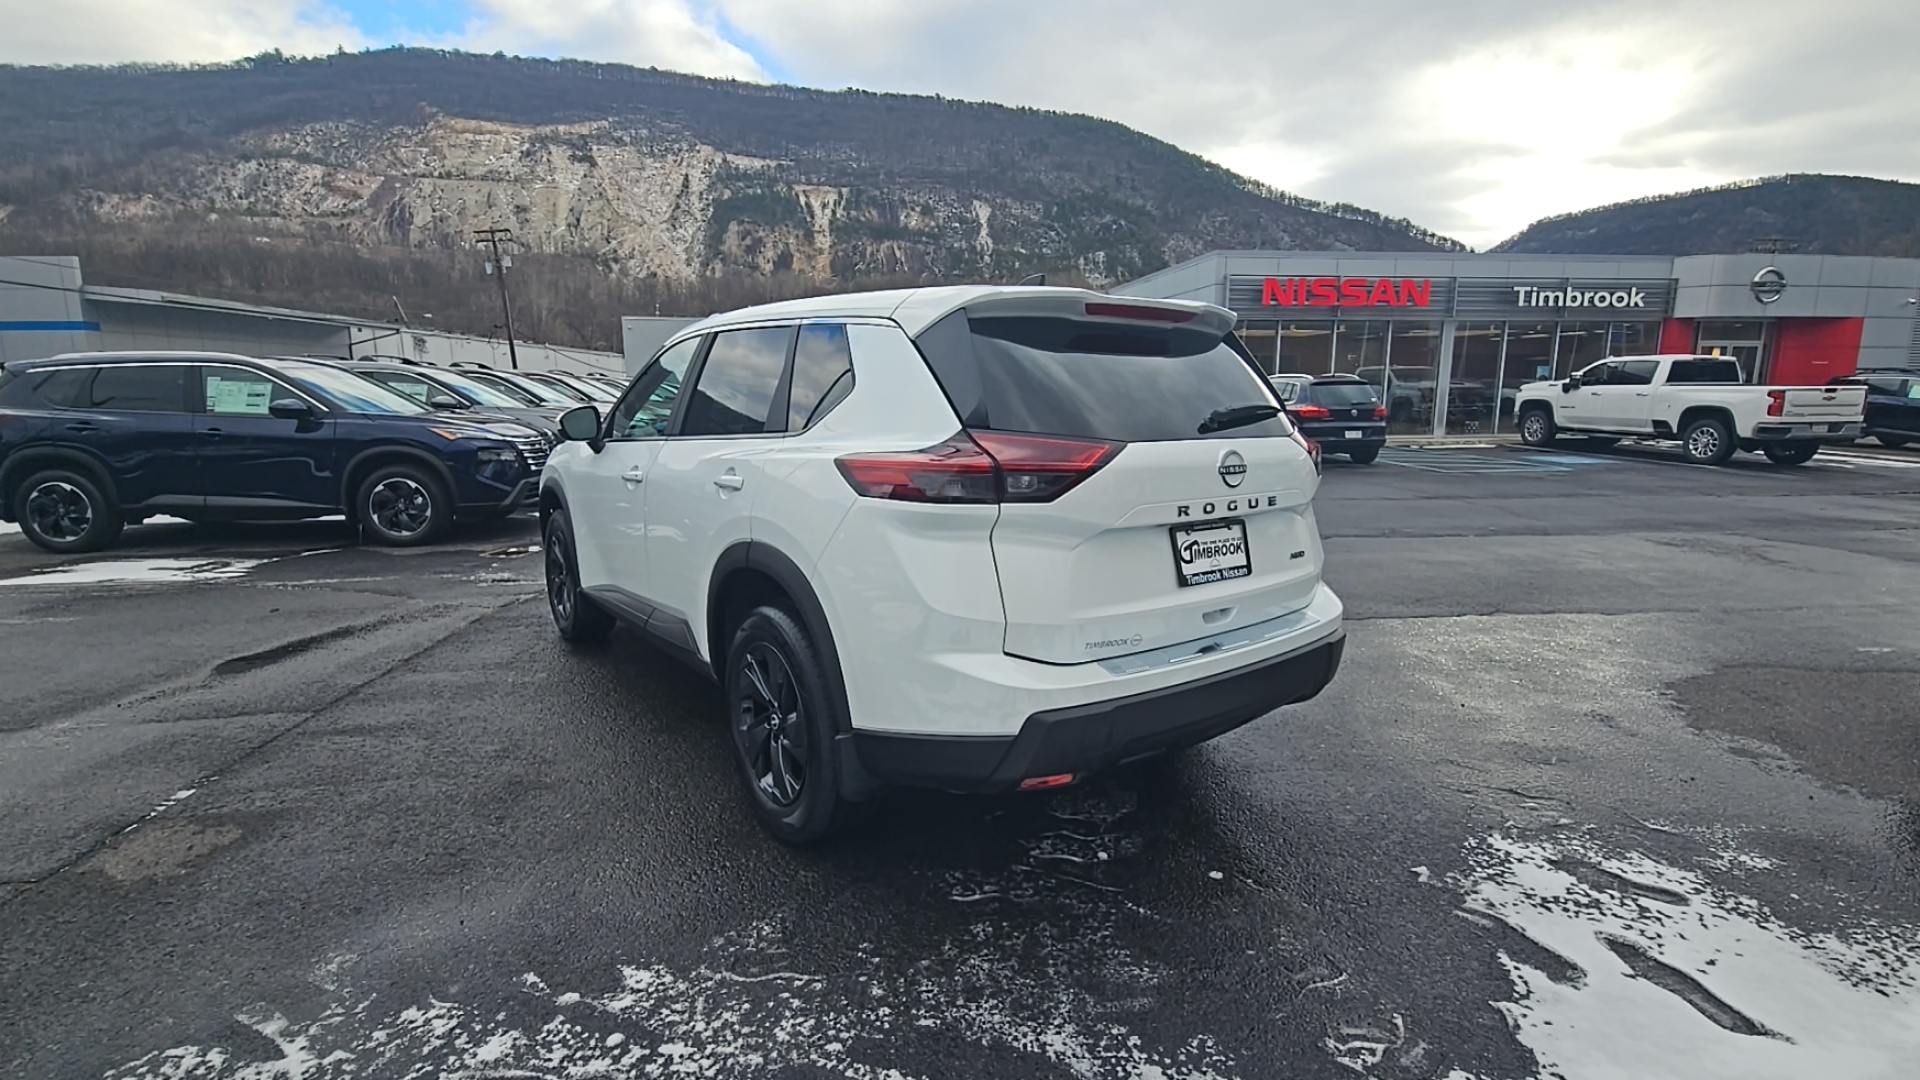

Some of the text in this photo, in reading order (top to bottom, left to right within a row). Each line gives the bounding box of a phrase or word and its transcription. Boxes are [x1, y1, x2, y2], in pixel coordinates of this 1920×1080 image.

[1262, 278, 1432, 307] NISSAN
[1513, 286, 1646, 308] Timbrook
[1219, 465, 1246, 474] NISSAN
[1177, 496, 1278, 517] ROGUE
[1180, 539, 1244, 564] TIMBROOK
[1186, 567, 1248, 585] Timbrook Nissan
[1085, 638, 1130, 650] TIMBROOK
